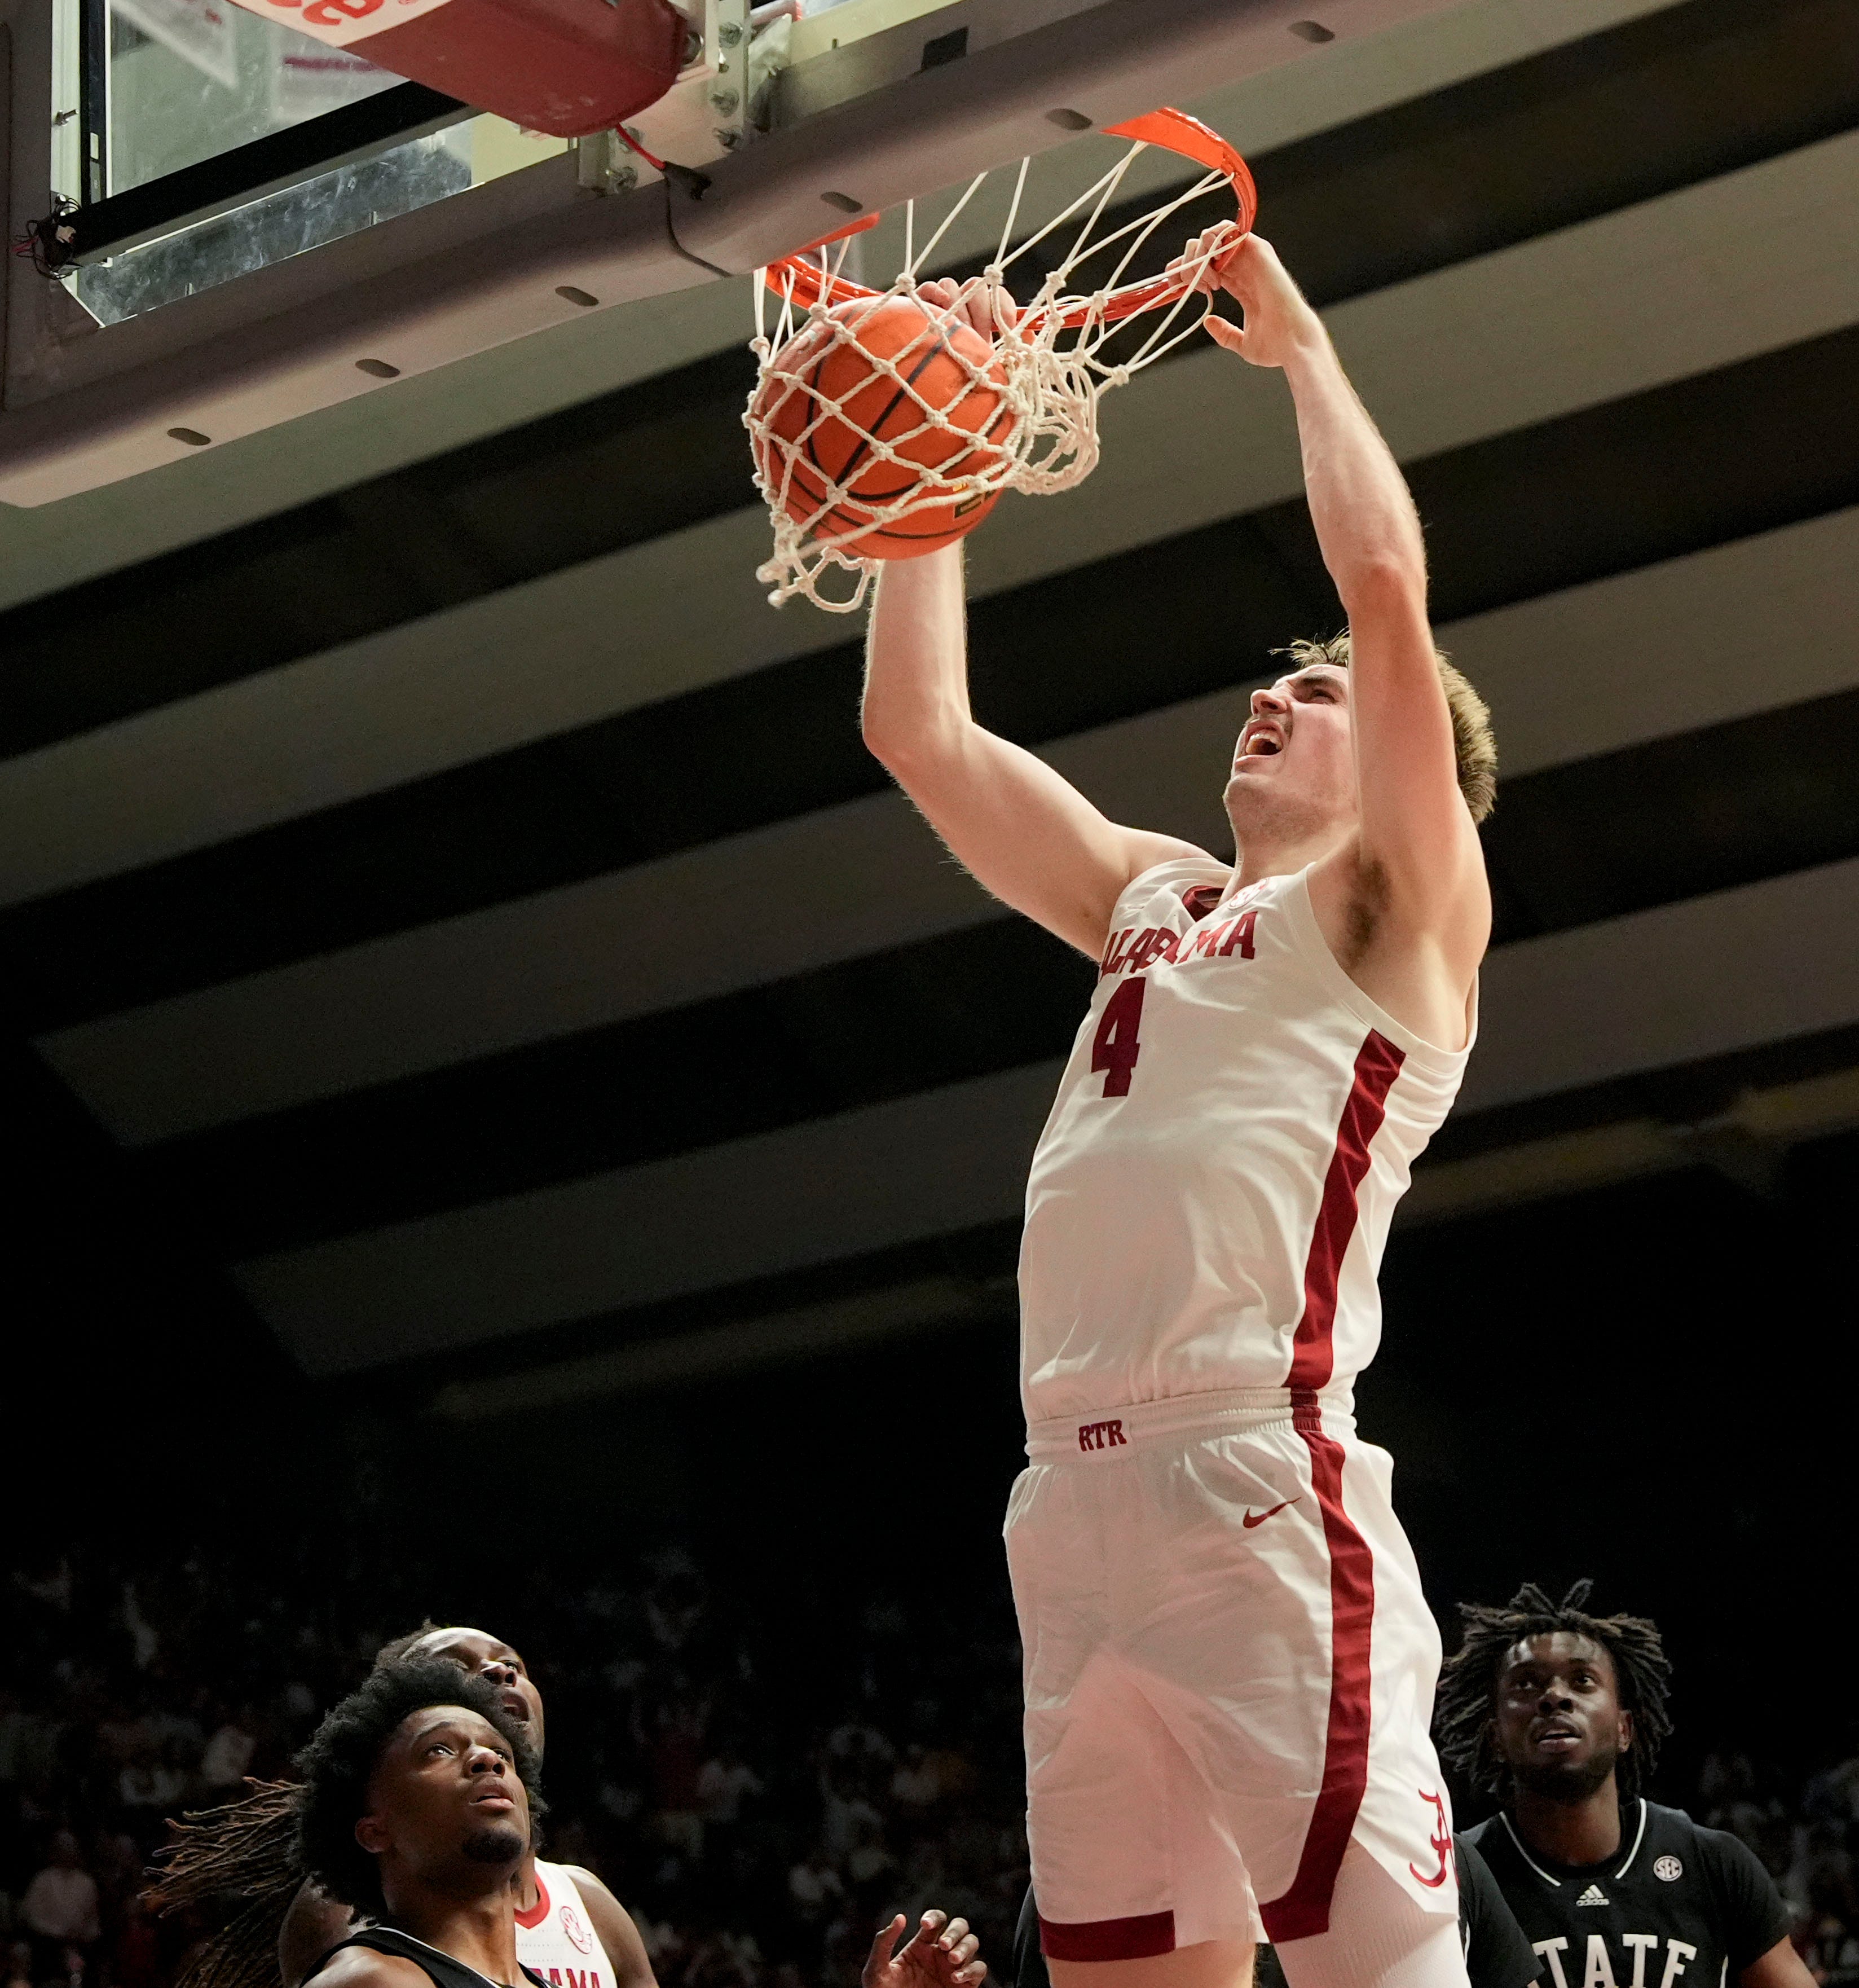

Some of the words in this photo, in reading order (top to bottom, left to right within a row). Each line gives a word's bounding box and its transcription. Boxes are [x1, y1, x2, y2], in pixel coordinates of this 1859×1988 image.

[1091, 977, 1146, 1098] 4
[1079, 1419, 1127, 1452] RTR
[1655, 1858, 1680, 1879] SEC
[1576, 1898, 1610, 1907] adidas
[1532, 1933, 1697, 1988] TATE
